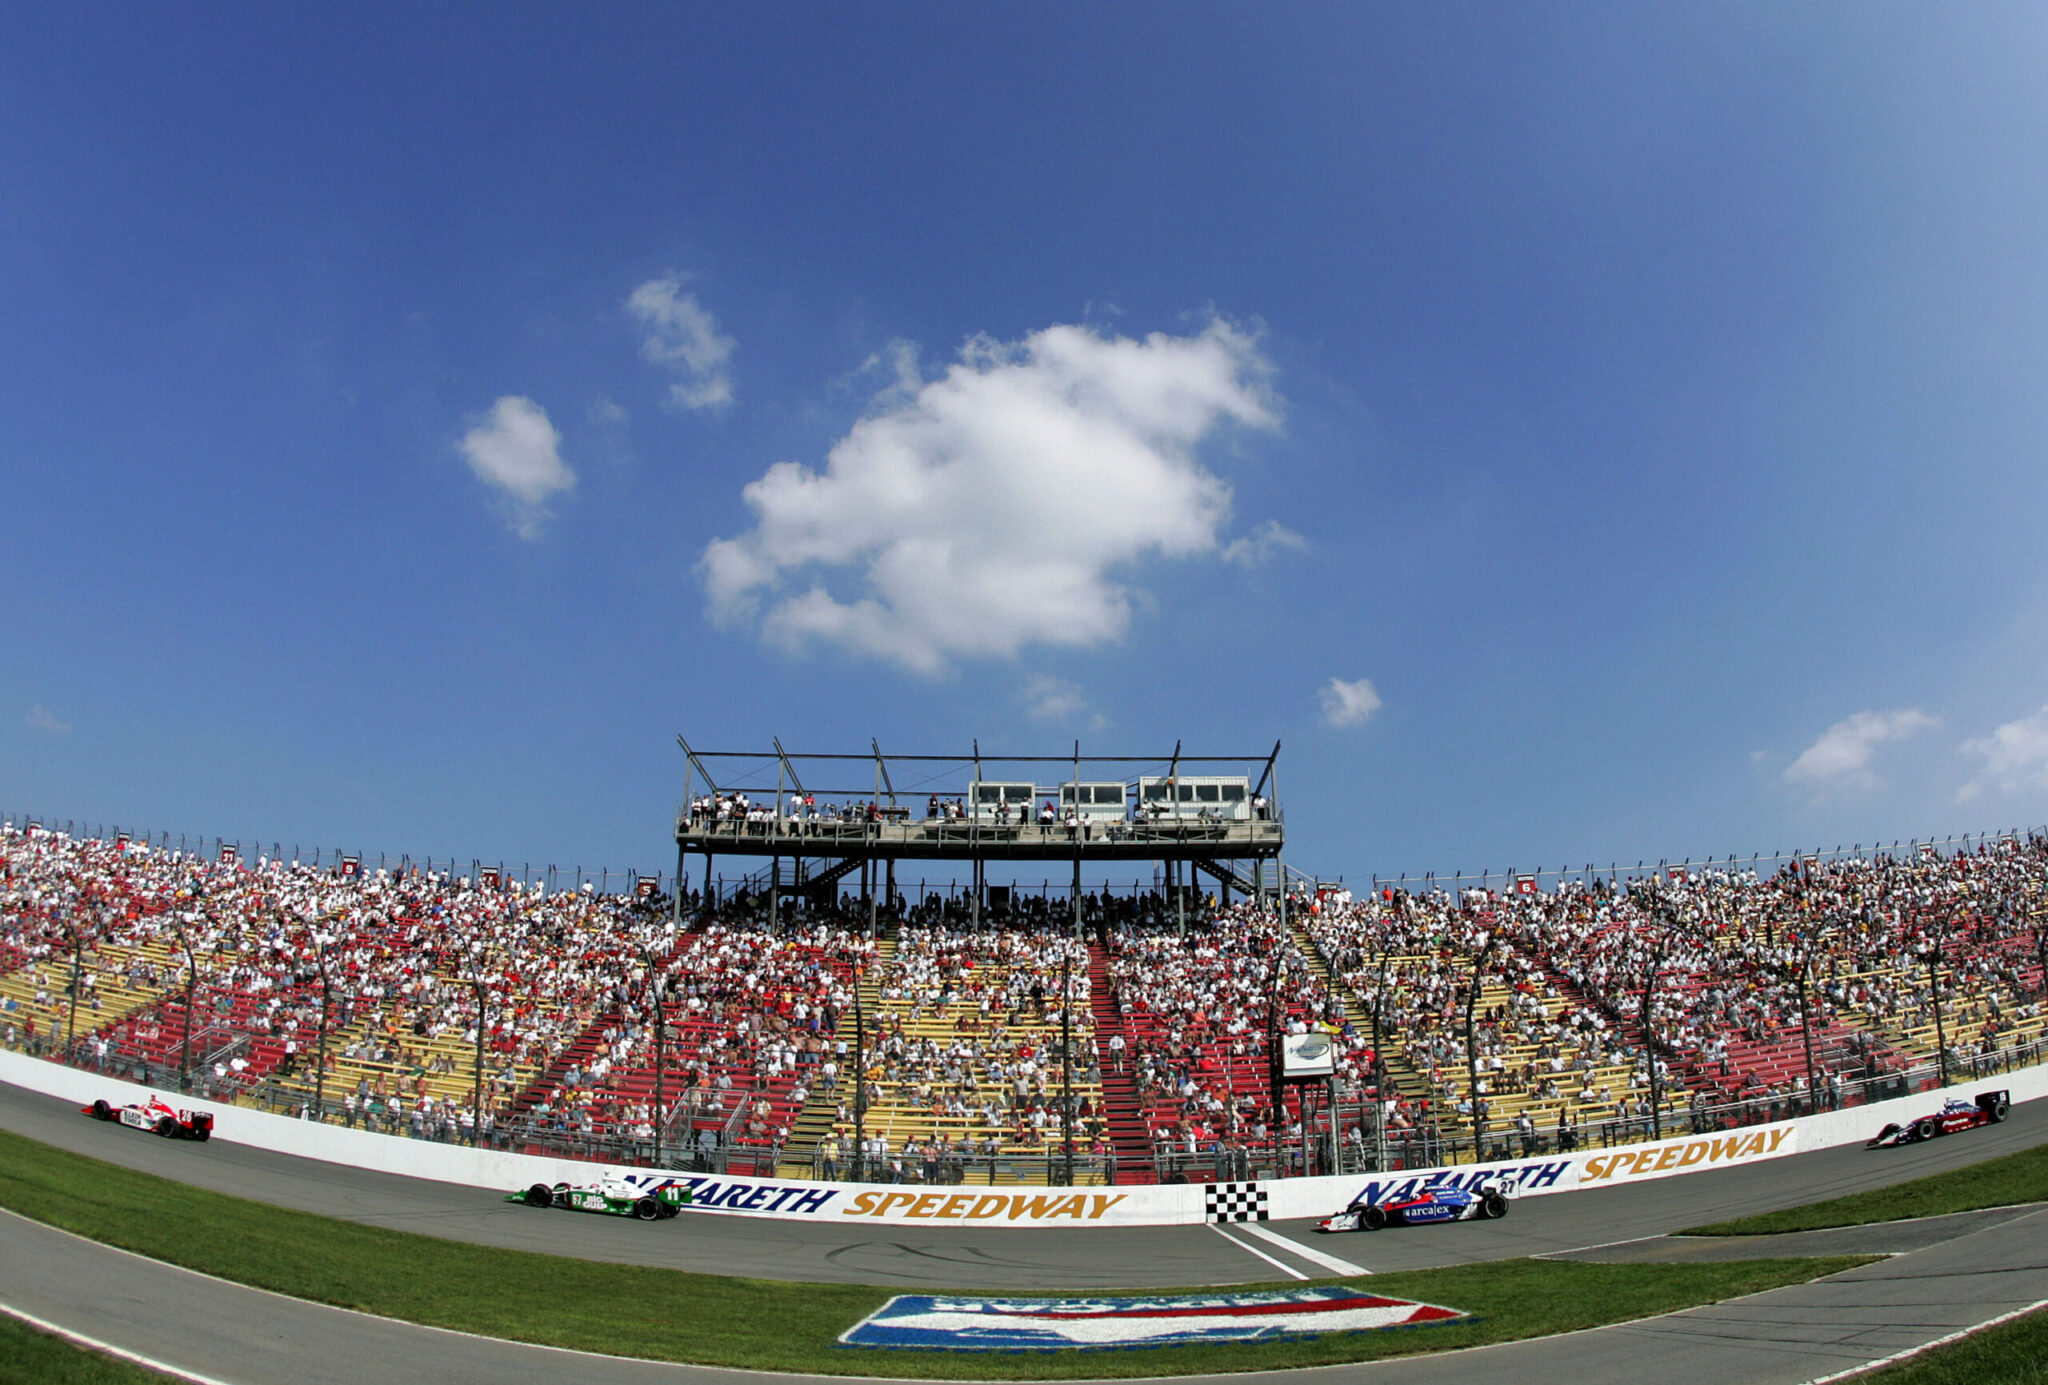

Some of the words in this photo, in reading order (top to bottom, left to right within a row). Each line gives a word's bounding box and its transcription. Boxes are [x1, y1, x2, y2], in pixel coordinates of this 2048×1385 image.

[345, 864, 353, 874] 9
[643, 885, 651, 895] 5
[1522, 883, 1531, 892] 6
[1580, 1126, 1795, 1183] SPEEDWAY
[1500, 1180, 1516, 1194] 27
[665, 1186, 679, 1201] 11
[582, 1201, 608, 1210] GULP
[843, 1191, 1129, 1221] SPEEDWAY
